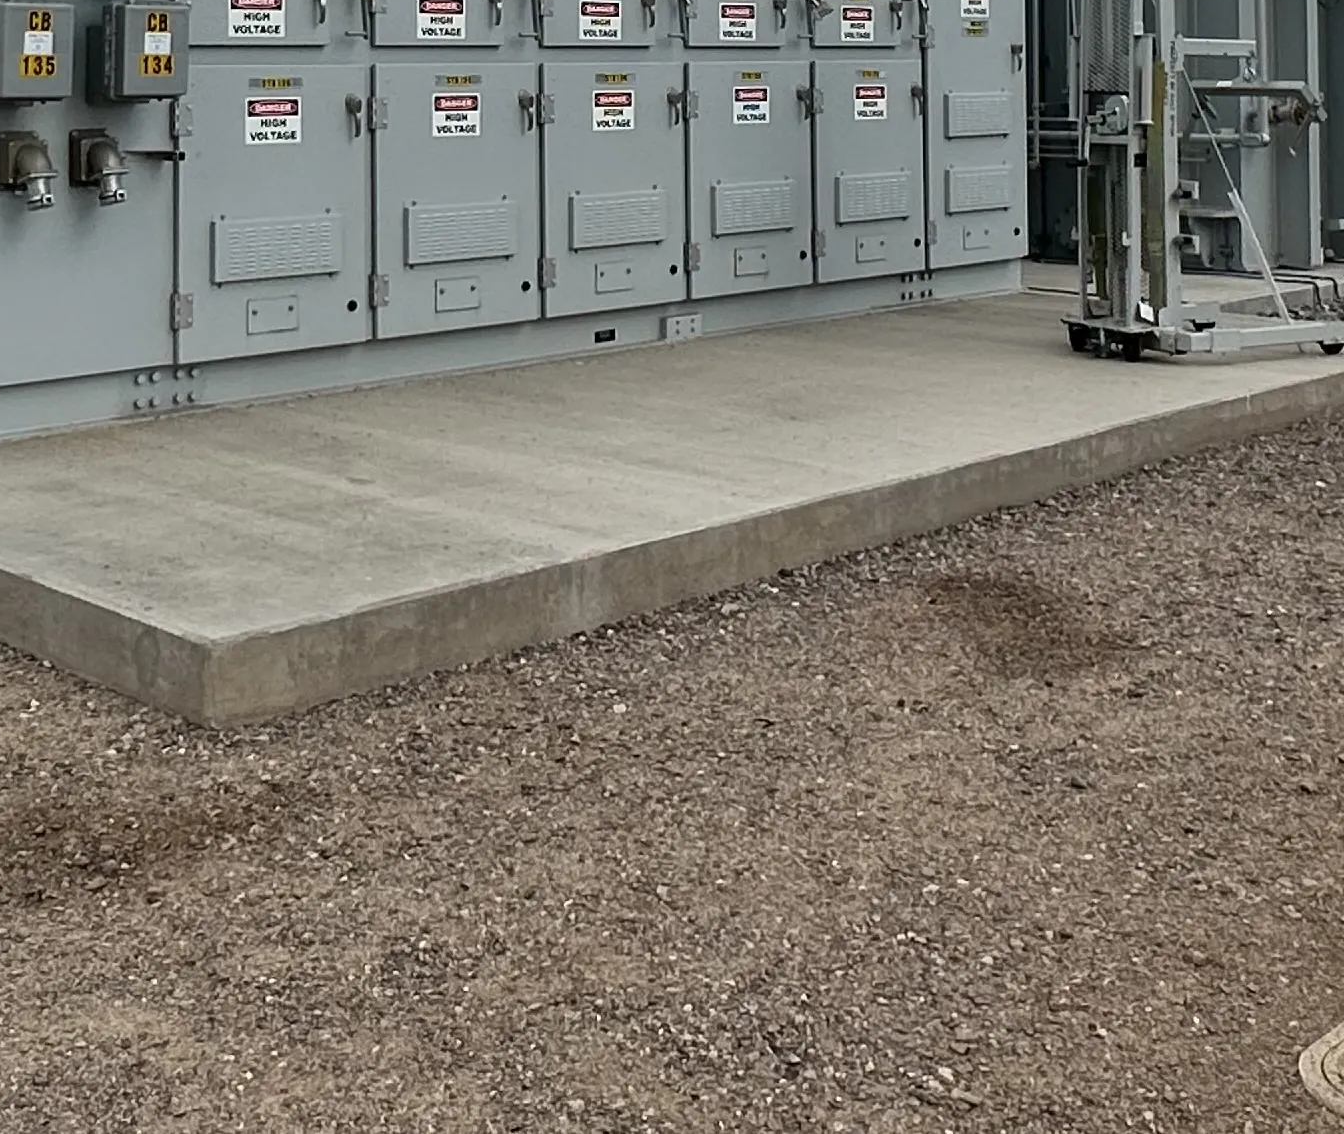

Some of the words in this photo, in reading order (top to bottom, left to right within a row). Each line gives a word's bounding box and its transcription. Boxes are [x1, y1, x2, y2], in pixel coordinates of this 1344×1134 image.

[427, 2, 458, 10] DANGER
[30, 11, 52, 31] CB
[244, 13, 270, 21] HIGH
[430, 16, 453, 24] HIGH
[148, 13, 168, 32] CB
[233, 25, 281, 34] VOLTAGE
[421, 27, 462, 36] VOLTAGE
[583, 29, 617, 37] VOLTAGE
[23, 56, 55, 76] 135
[143, 55, 173, 74] 134
[255, 102, 292, 113] DANGER
[440, 99, 472, 107] DANGER
[261, 118, 287, 127] HIGH
[596, 119, 631, 127] VOLTAGE
[436, 124, 477, 133] VOLTAGE
[250, 131, 297, 141] VOLTAGE
